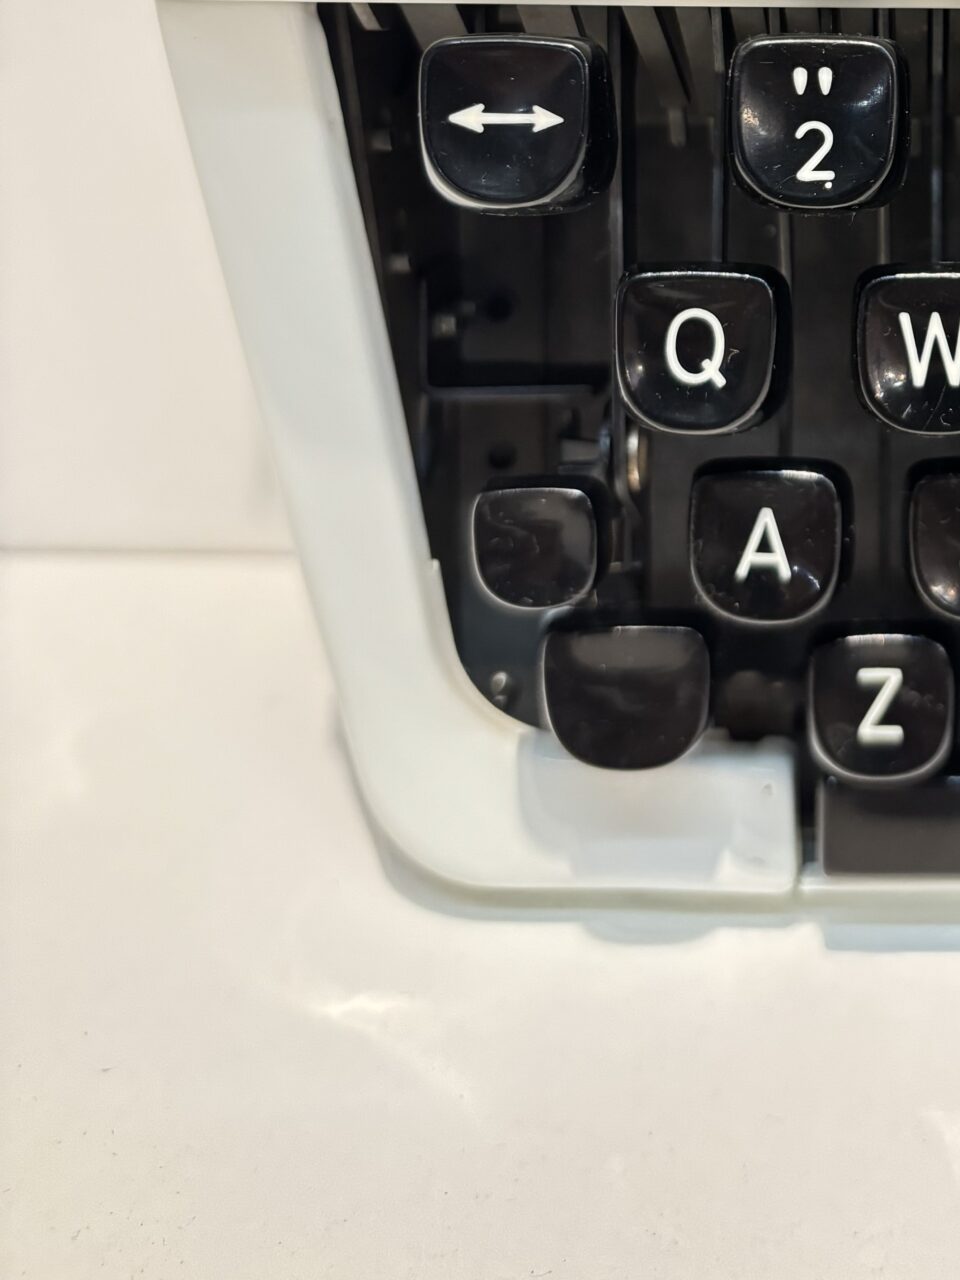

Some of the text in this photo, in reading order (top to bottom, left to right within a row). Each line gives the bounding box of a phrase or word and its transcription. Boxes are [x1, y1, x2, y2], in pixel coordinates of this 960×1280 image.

[794, 120, 836, 182] 2
[665, 307, 727, 388] Q
[735, 506, 792, 581] A
[856, 667, 904, 745] Z
